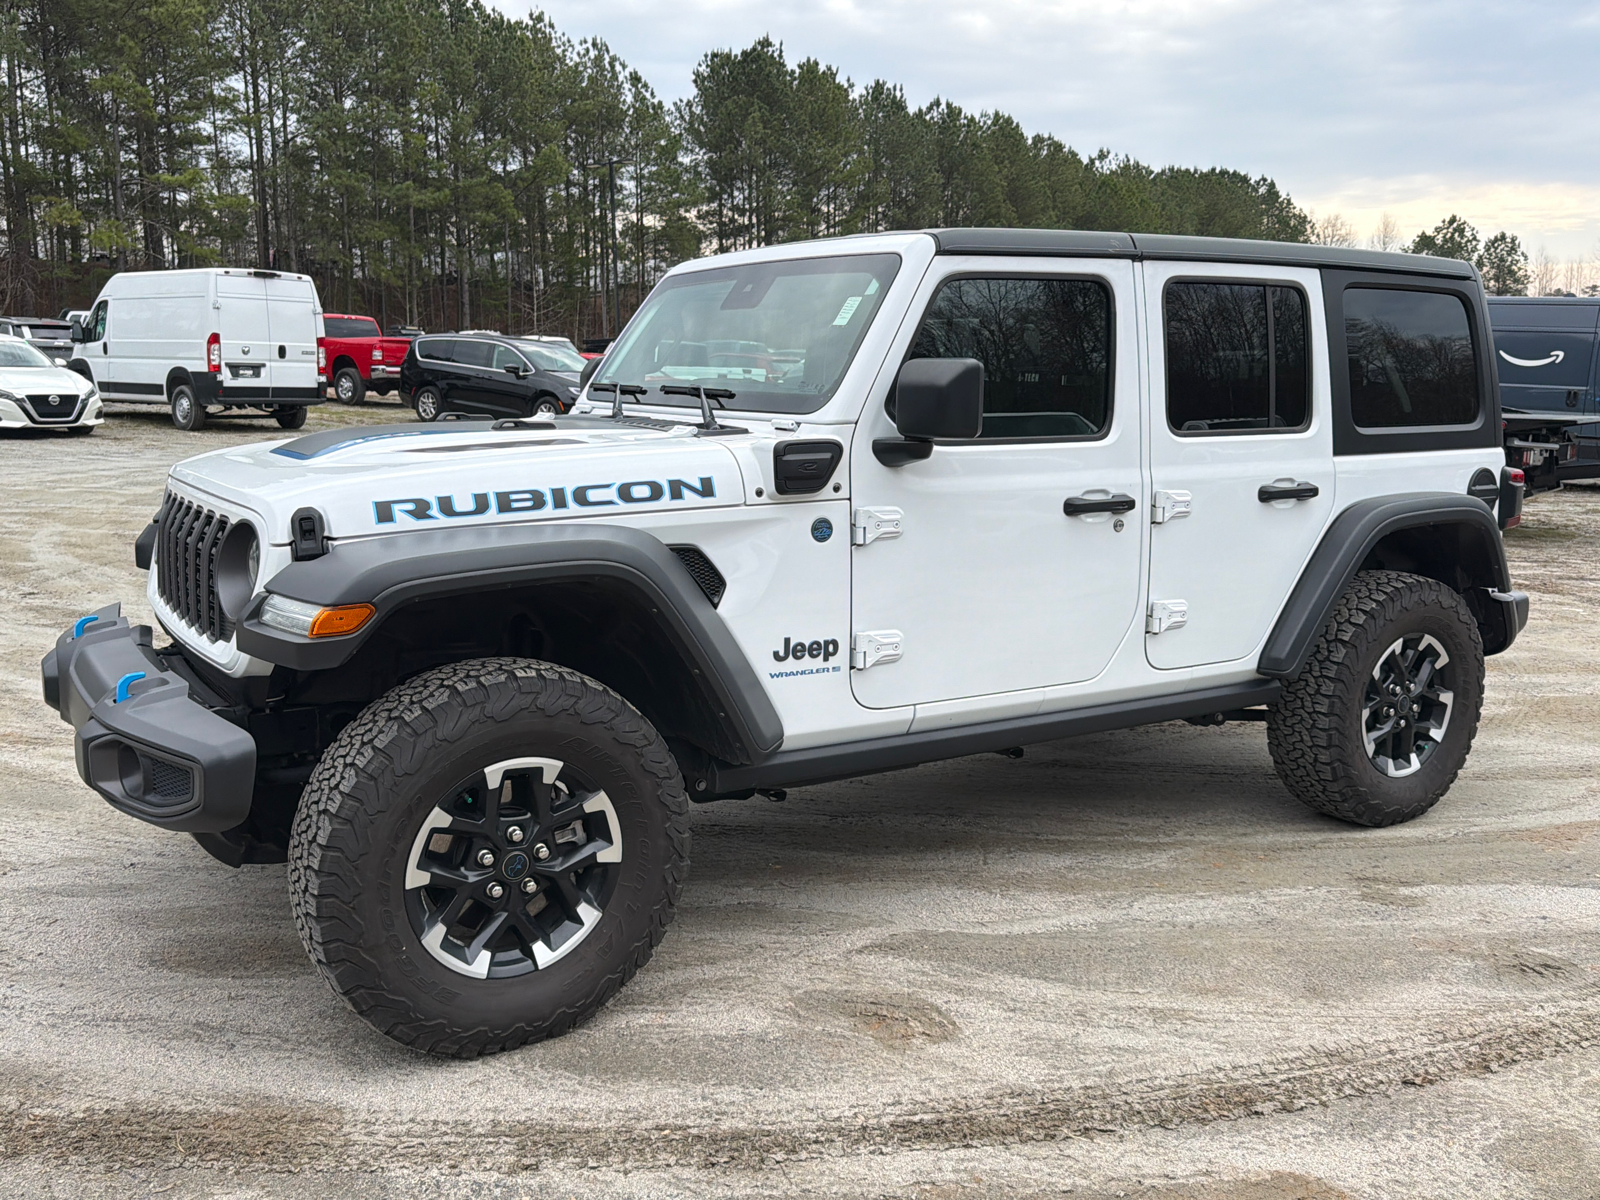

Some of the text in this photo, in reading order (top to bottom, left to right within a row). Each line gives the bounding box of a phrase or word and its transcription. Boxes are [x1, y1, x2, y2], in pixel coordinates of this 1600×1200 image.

[372, 475, 717, 525] RUBICON
[773, 637, 839, 662] Jeep
[769, 667, 830, 679] WRANGLER
